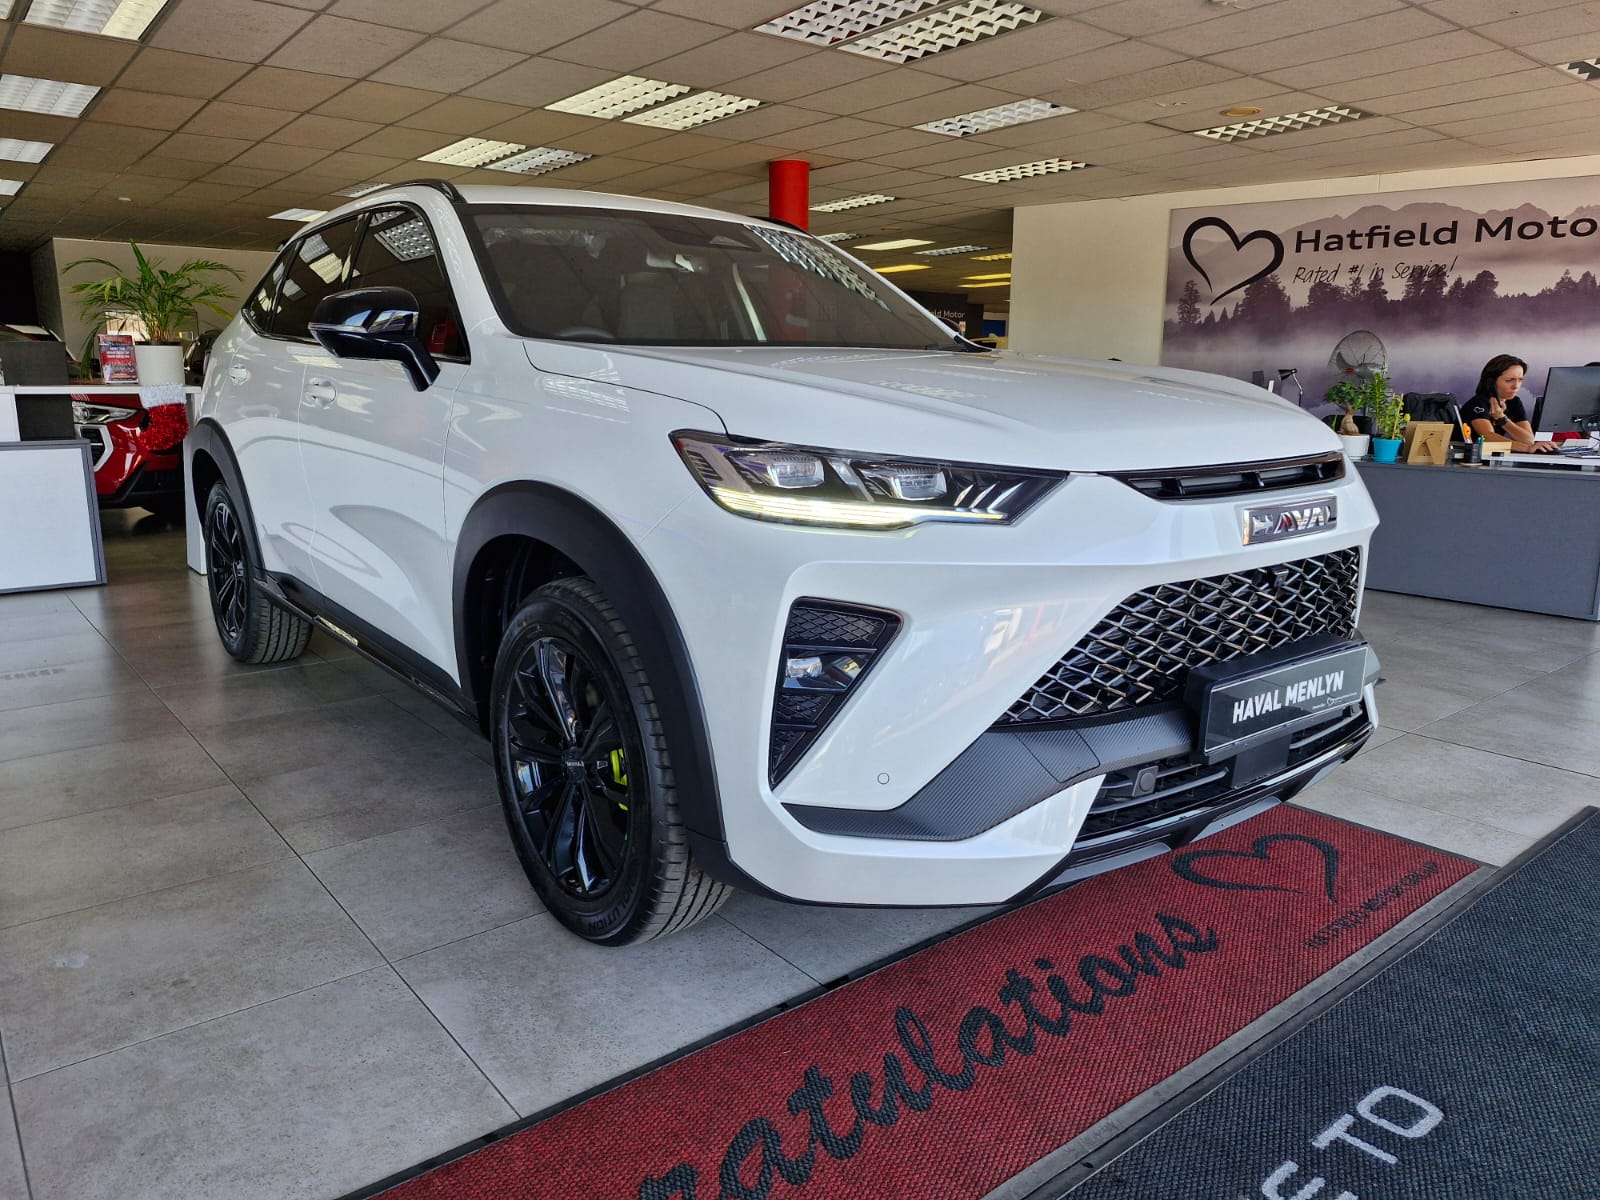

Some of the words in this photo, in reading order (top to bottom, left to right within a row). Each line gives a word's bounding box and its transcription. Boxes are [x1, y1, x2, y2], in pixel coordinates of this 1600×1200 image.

[1295, 220, 1458, 253] Hatfield
[1475, 215, 1598, 242] Moto
[1292, 263, 1341, 283] Rated
[1348, 264, 1365, 281] #1
[1369, 262, 1385, 281] in
[1232, 689, 1282, 724] HAVAL
[1285, 670, 1345, 706] MENLYN
[1311, 1085, 1444, 1164] TO
